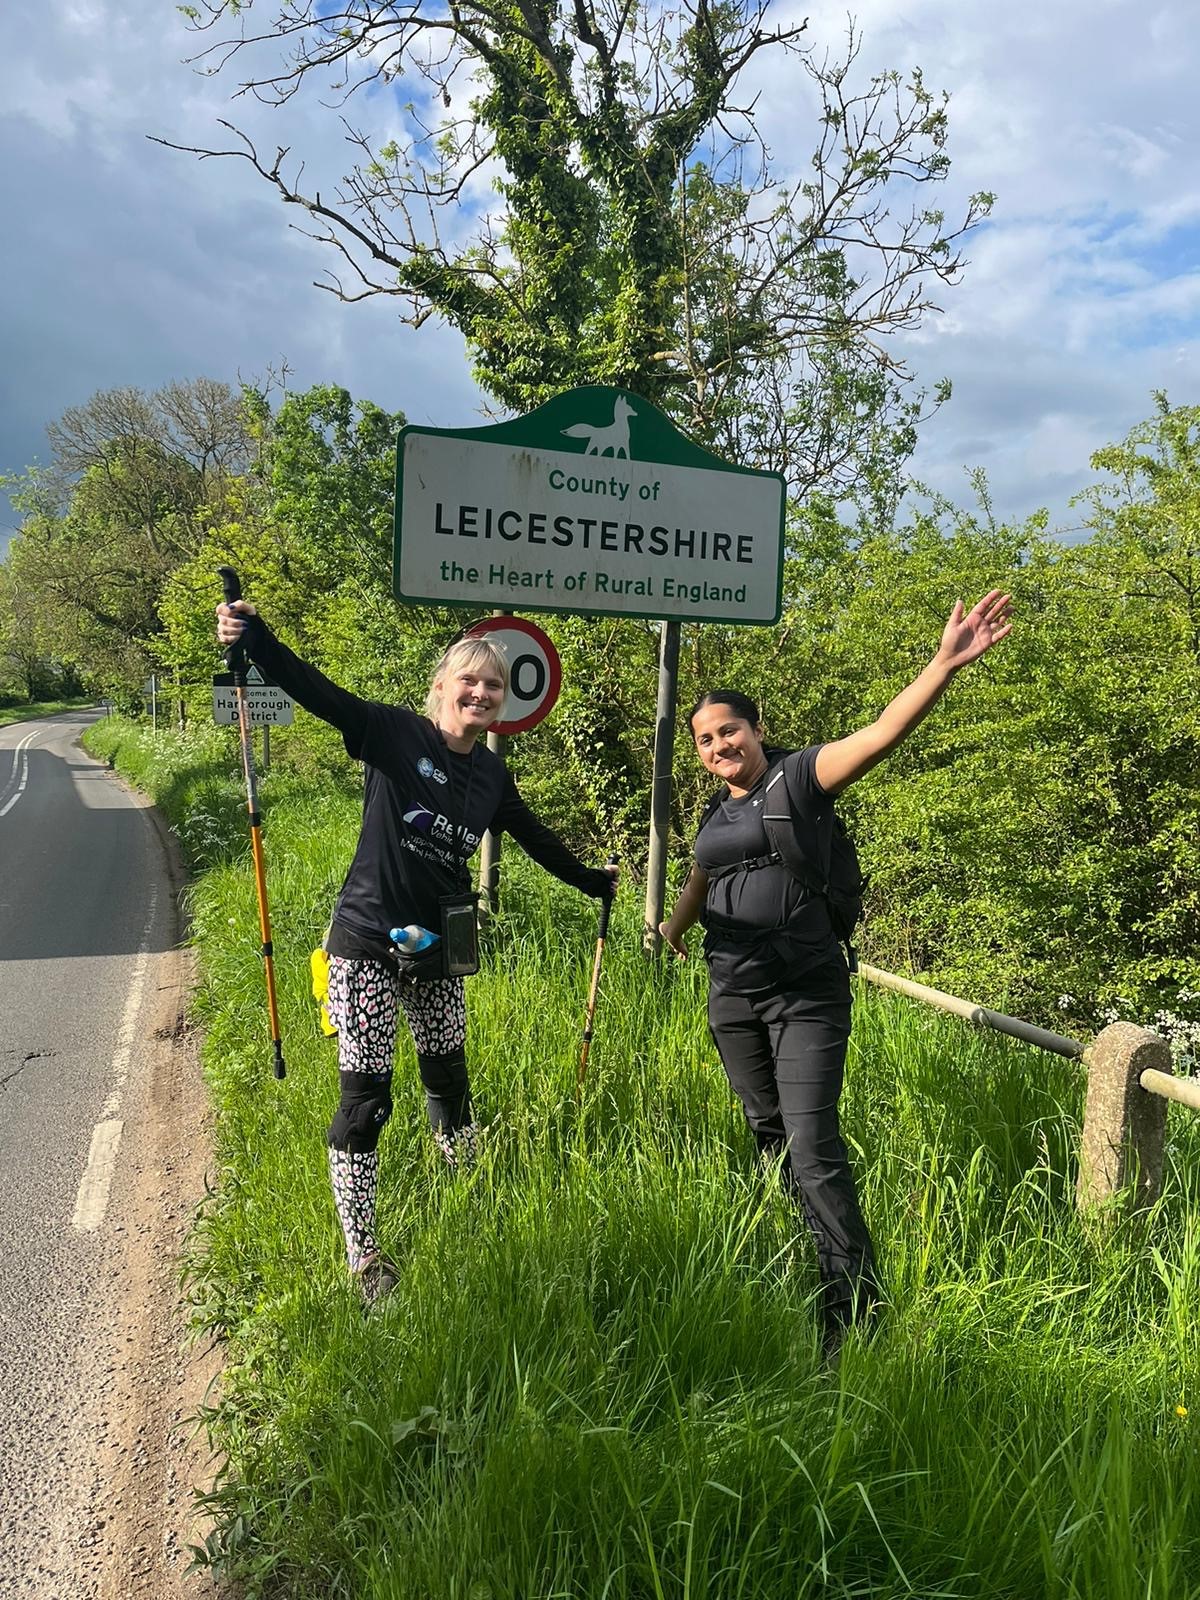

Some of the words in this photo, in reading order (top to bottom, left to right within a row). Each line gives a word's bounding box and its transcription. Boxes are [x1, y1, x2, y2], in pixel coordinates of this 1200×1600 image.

[549, 469, 630, 501] County
[639, 481, 660, 501] of
[435, 503, 754, 564] LEICESTERSHIRE
[440, 561, 479, 583] the
[489, 565, 554, 589] Heart
[564, 571, 587, 591] of
[595, 573, 652, 597] Rural
[664, 578, 746, 603] England
[510, 654, 545, 701] 0
[217, 699, 291, 711] Harorough
[231, 711, 277, 721] Dtrict
